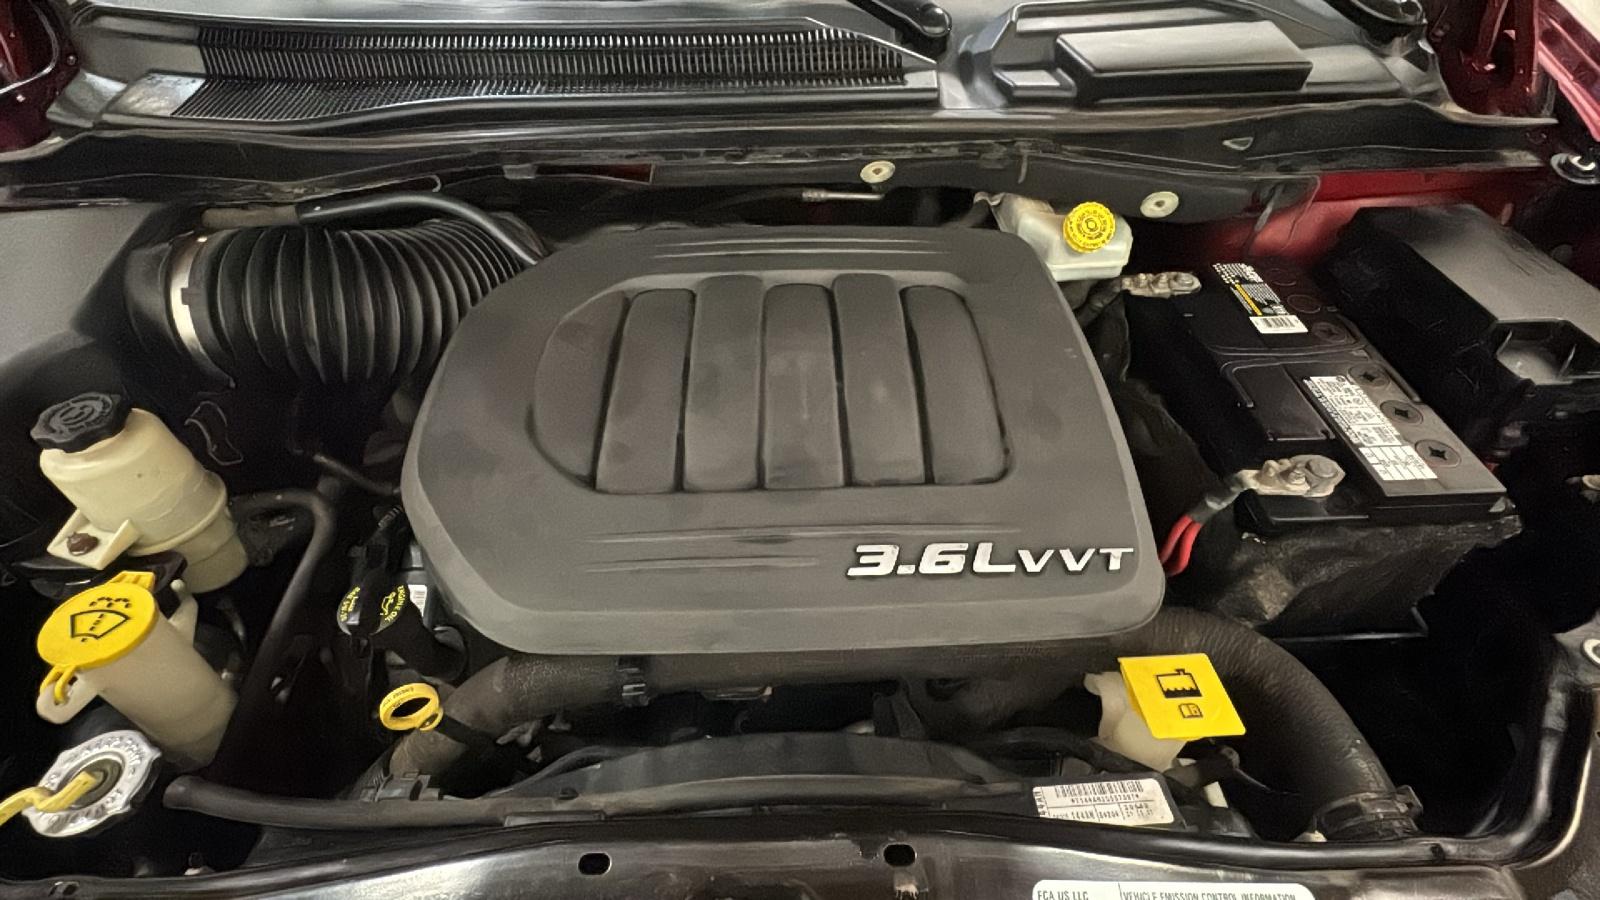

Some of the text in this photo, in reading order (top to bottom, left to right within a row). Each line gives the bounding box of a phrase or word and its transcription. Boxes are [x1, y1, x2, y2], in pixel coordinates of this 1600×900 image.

[847, 542, 1135, 576] 3.6L VVT
[384, 611, 398, 622] OIL
[1037, 890, 1055, 900] FCA
[1057, 891, 1070, 900] US
